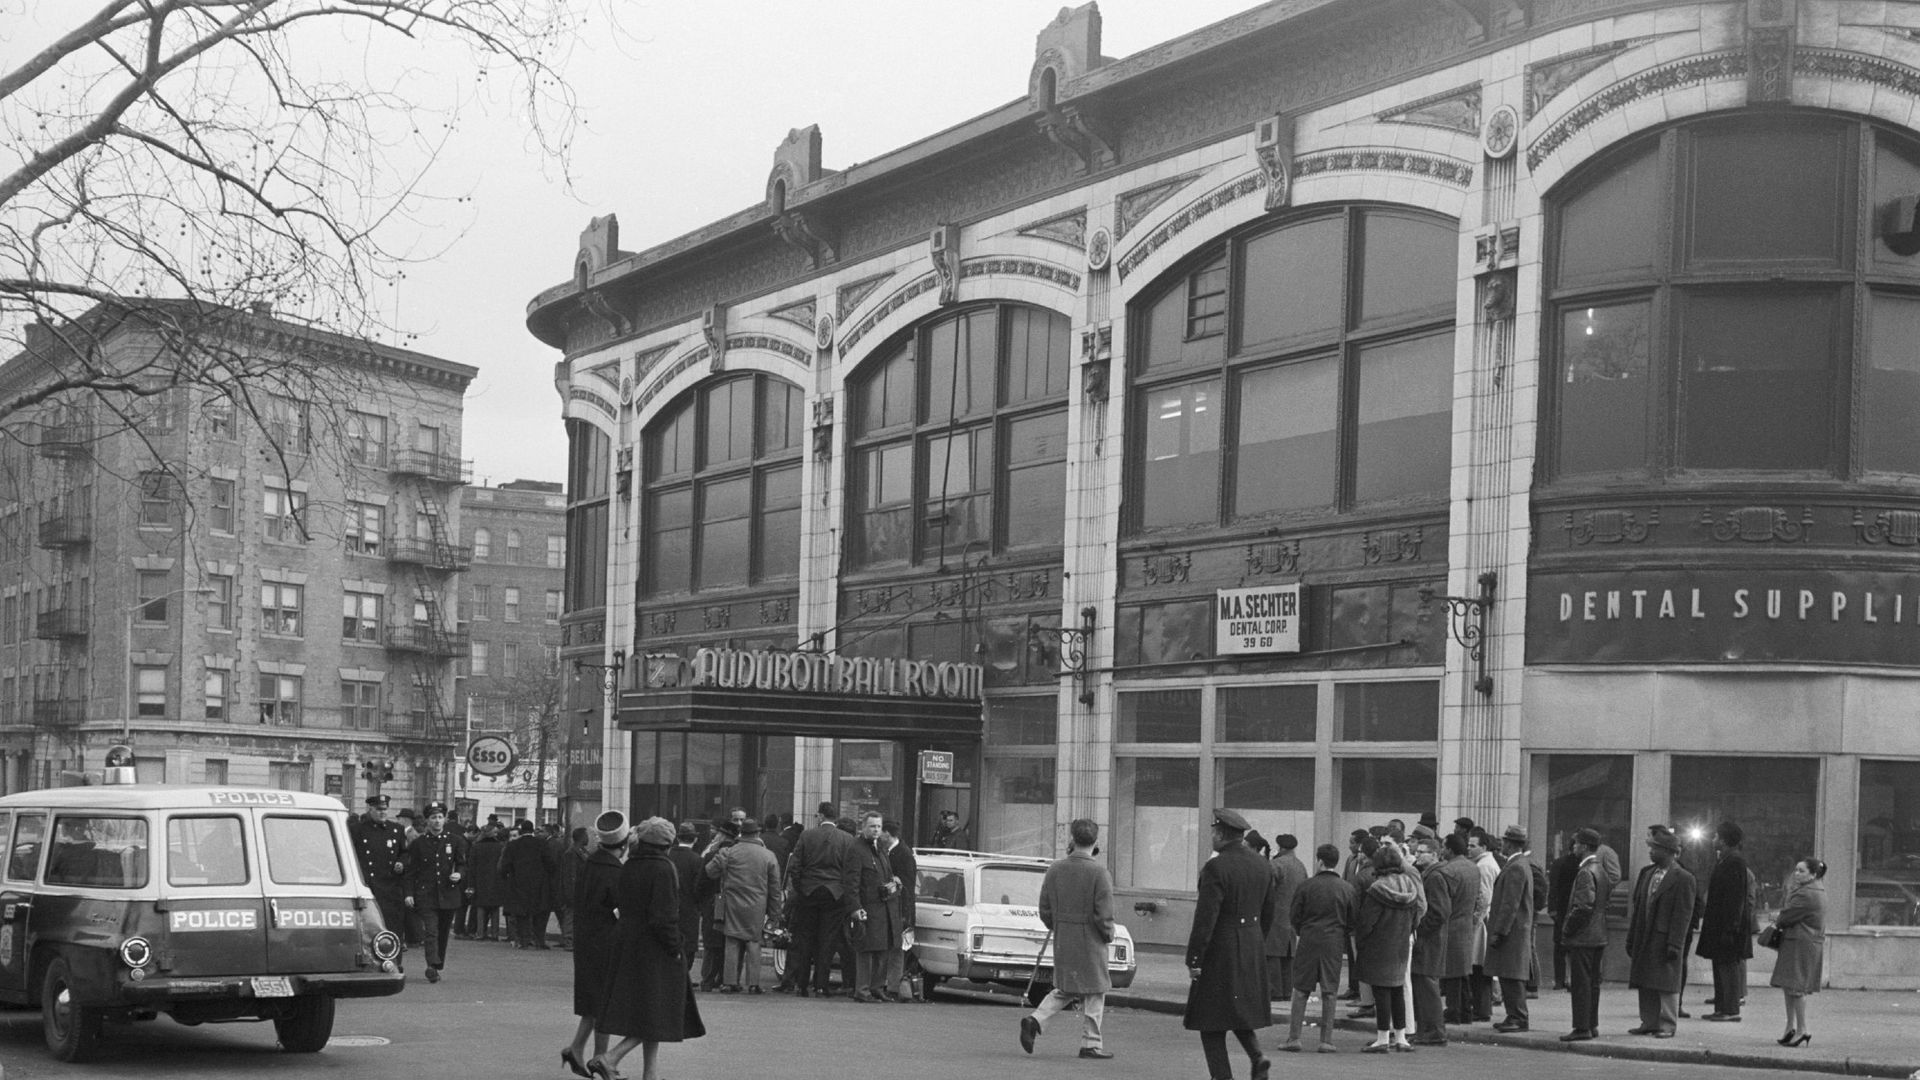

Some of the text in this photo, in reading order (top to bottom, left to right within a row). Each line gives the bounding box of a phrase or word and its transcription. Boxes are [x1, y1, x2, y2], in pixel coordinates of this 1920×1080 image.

[1560, 588, 1705, 622] DENTAL
[1230, 619, 1288, 636] DENTAL CORP.
[699, 649, 830, 692] AUDUBON
[838, 656, 984, 700] BALLROOM
[926, 761, 950, 769] STANDING
[932, 754, 945, 762] NO
[213, 792, 294, 805] POLICE
[173, 911, 256, 928] POLICE
[279, 910, 355, 927] POLICE
